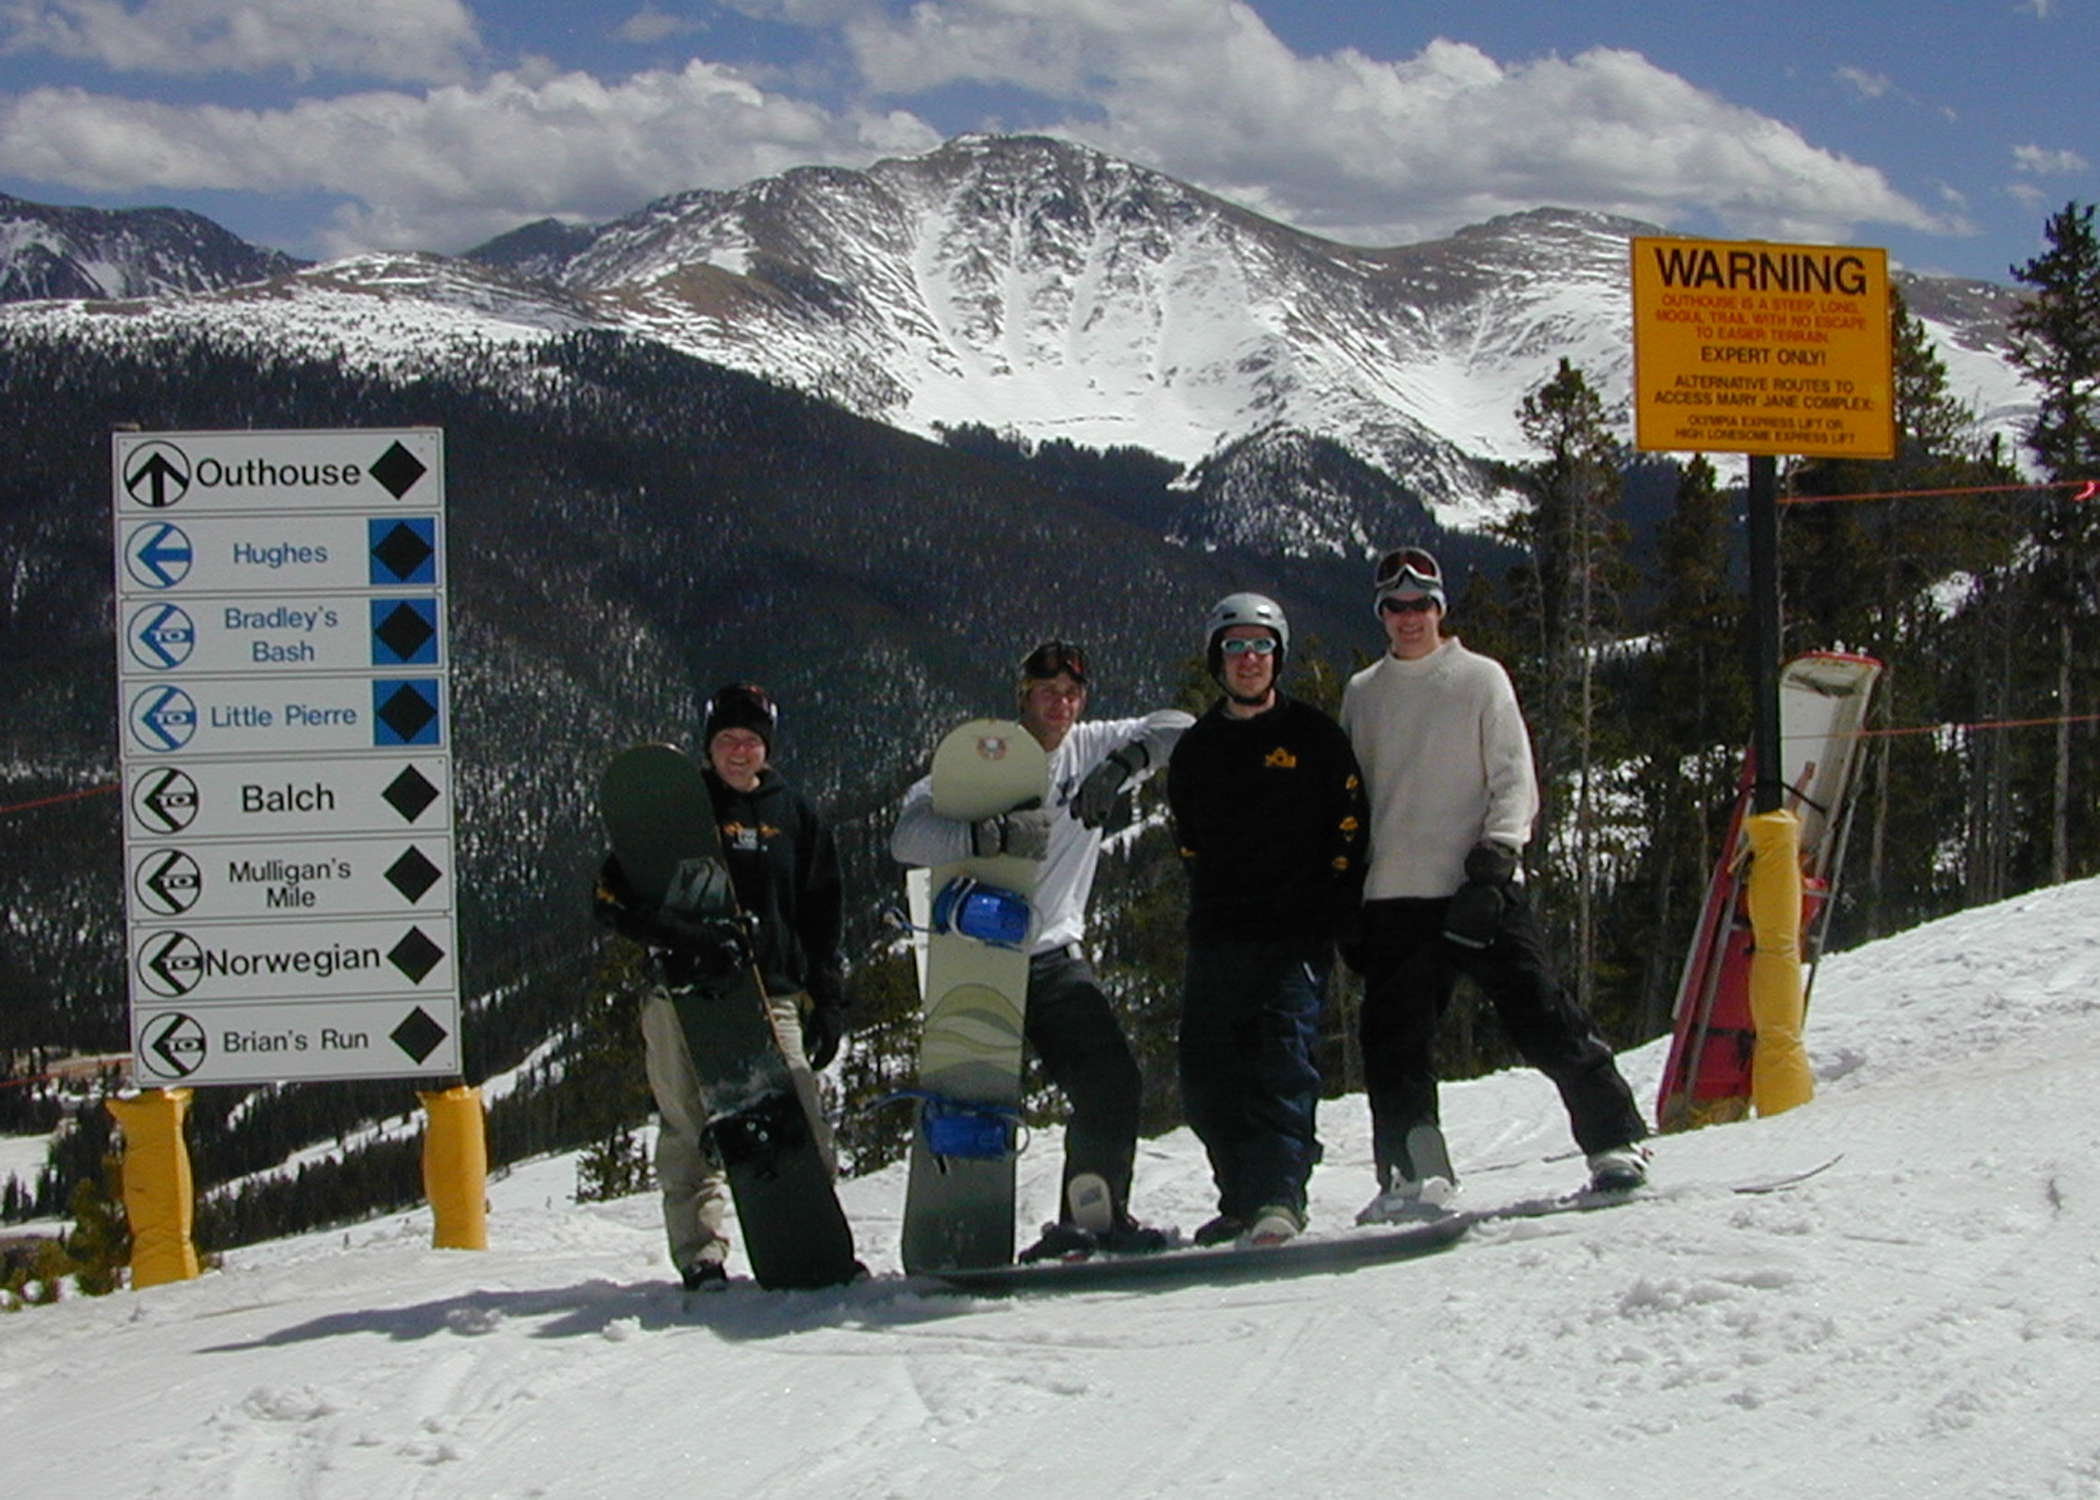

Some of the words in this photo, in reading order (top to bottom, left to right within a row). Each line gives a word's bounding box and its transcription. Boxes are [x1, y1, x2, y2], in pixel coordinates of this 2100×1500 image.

[1654, 247, 1867, 296] WARNING
[1662, 293, 1737, 309] OUTHOUSE
[1741, 297, 1753, 310] IS
[1759, 298, 1768, 310] A
[1656, 309, 1704, 323] MOGUL
[1753, 313, 1786, 326] WITH
[1792, 315, 1812, 328] NO
[1815, 316, 1866, 331] ESCAPE
[1696, 326, 1713, 339] TO
[1718, 327, 1765, 341] EASIER
[1701, 346, 1770, 364] EXPERT
[1778, 349, 1826, 366] ONLY!
[1675, 374, 1767, 391] ALTERNATIVE
[1774, 377, 1830, 393] ROUTES
[1836, 380, 1855, 395] TO
[1654, 390, 1712, 406] ACCESS
[1717, 392, 1757, 407] MARY
[1762, 395, 1797, 408] JANE
[1687, 414, 1737, 427] OLYMPIA
[1742, 416, 1794, 429] EXPRESS
[1798, 417, 1822, 430] LIFT
[1826, 418, 1844, 431] OR
[1675, 427, 1704, 439] HIGH
[1708, 428, 1770, 441] LONESOME
[1775, 431, 1827, 444] EXPRESS
[1832, 432, 1855, 445] LIFT
[197, 457, 361, 487] Outhouse
[233, 543, 328, 568] Hughes
[224, 605, 338, 631] Bradley's
[252, 641, 315, 662] Bash
[211, 705, 273, 727] Little
[285, 704, 357, 726] Pierre
[241, 783, 335, 813] Balch
[228, 857, 352, 886] Mulligan's
[266, 887, 316, 908] Mile
[206, 943, 381, 978] Norwegian
[223, 1030, 308, 1053] Brian's
[321, 1028, 370, 1050] Run
